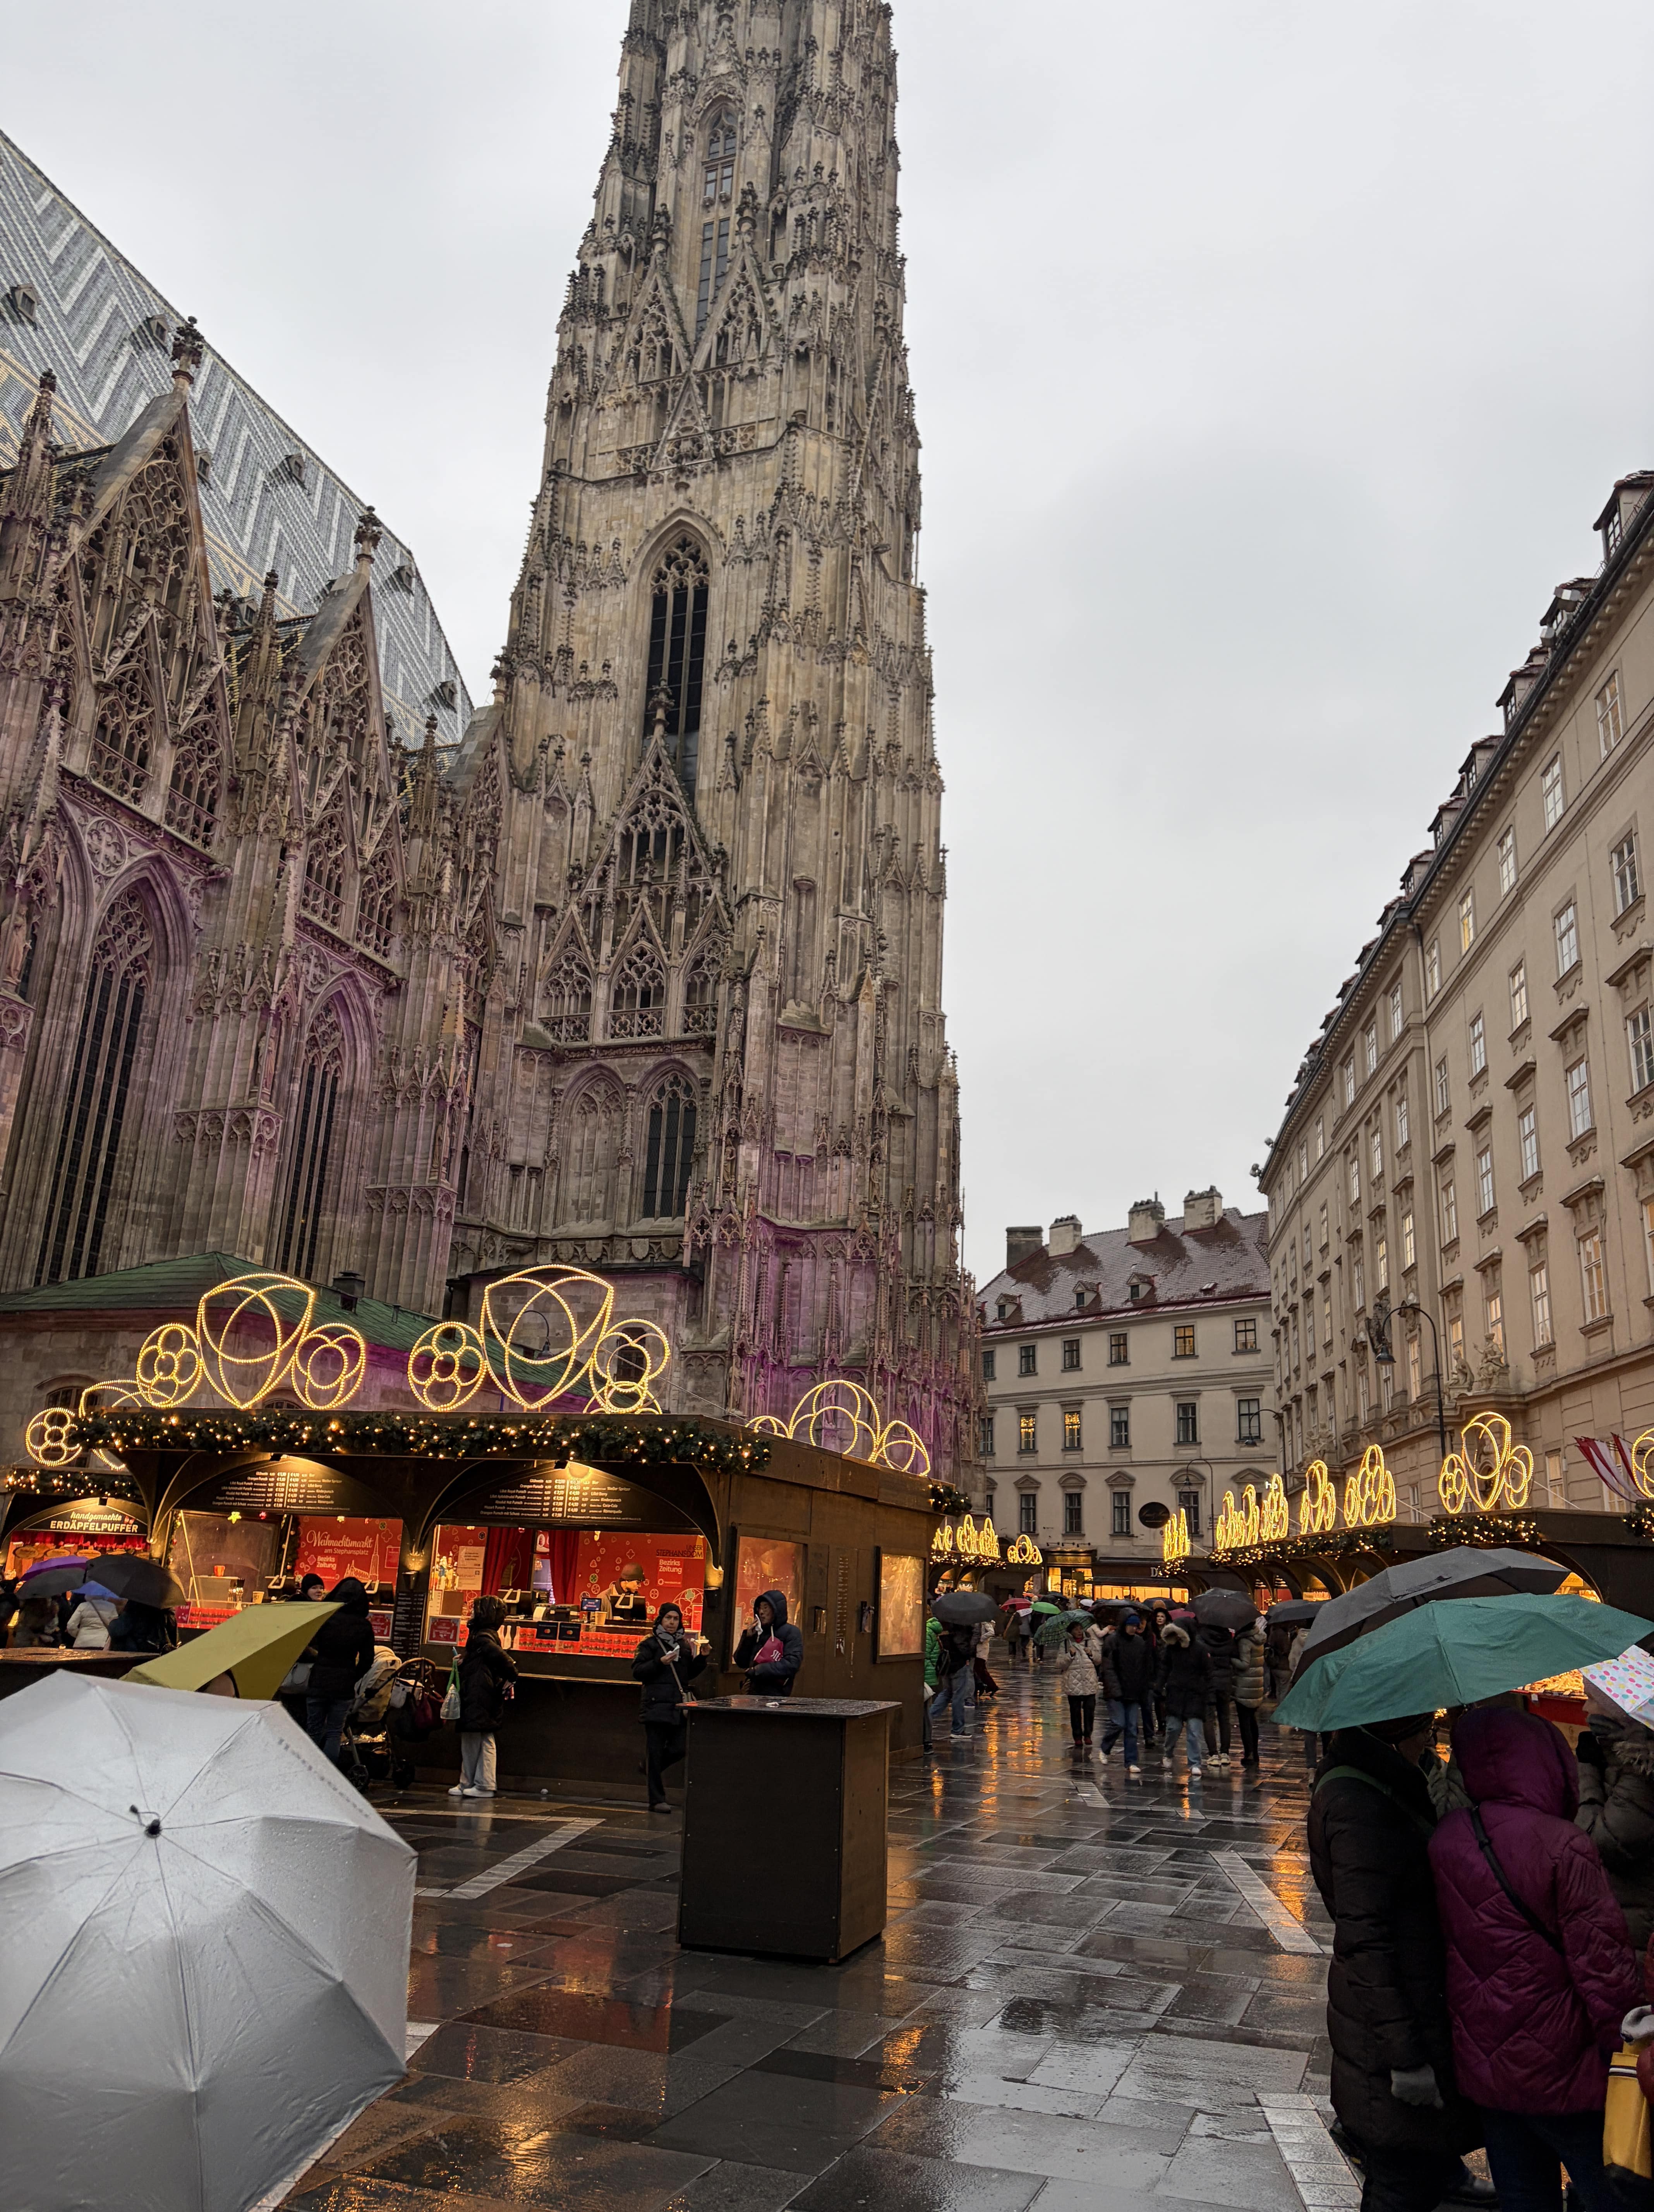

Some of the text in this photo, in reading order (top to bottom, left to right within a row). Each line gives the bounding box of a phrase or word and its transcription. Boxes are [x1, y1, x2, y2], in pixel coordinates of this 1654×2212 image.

[70, 1511, 122, 1522] handgemachte
[50, 1520, 138, 1532] ERDÄPFELPUFFER
[306, 1530, 374, 1548] Weihnachtsmarkt
[656, 1549, 703, 1558] STEPHANSDOM
[316, 1562, 336, 1570] Zeitung
[659, 1566, 682, 1574] Zeitung
